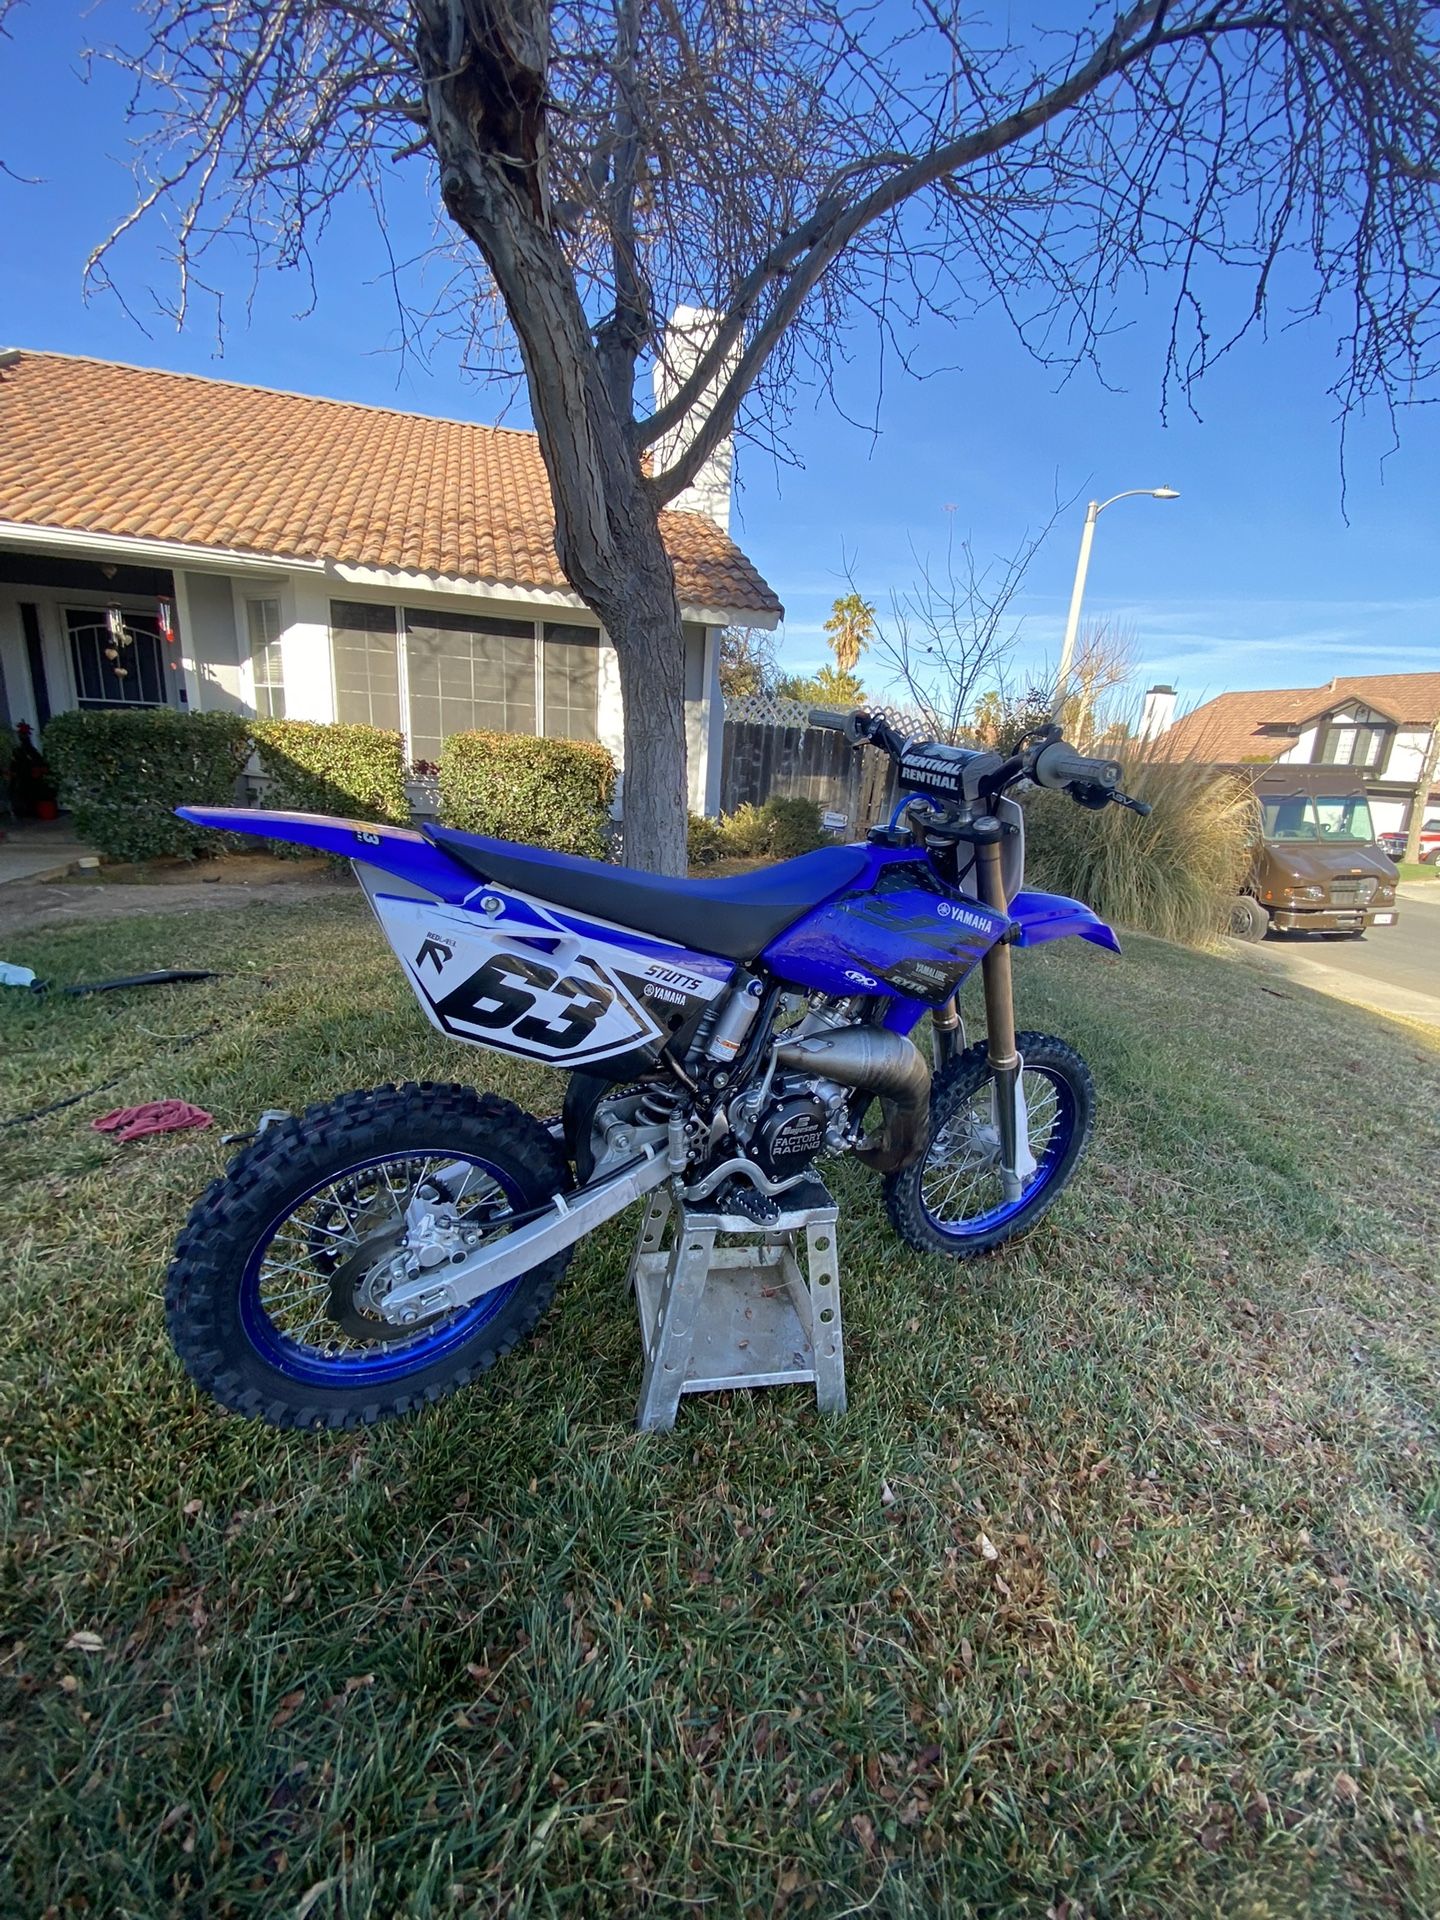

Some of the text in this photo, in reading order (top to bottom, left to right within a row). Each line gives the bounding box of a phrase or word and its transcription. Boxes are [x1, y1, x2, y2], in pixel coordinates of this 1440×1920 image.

[902, 754, 963, 775] RENTHAL
[901, 767, 959, 790] RENTHAL
[951, 906, 993, 934] YAMAHA
[644, 965, 703, 990] STUTTS
[436, 953, 614, 1050] 63
[654, 986, 687, 1006] YAMAHA
[772, 1141, 821, 1155] RACING
[775, 1131, 822, 1147] FACTORY
